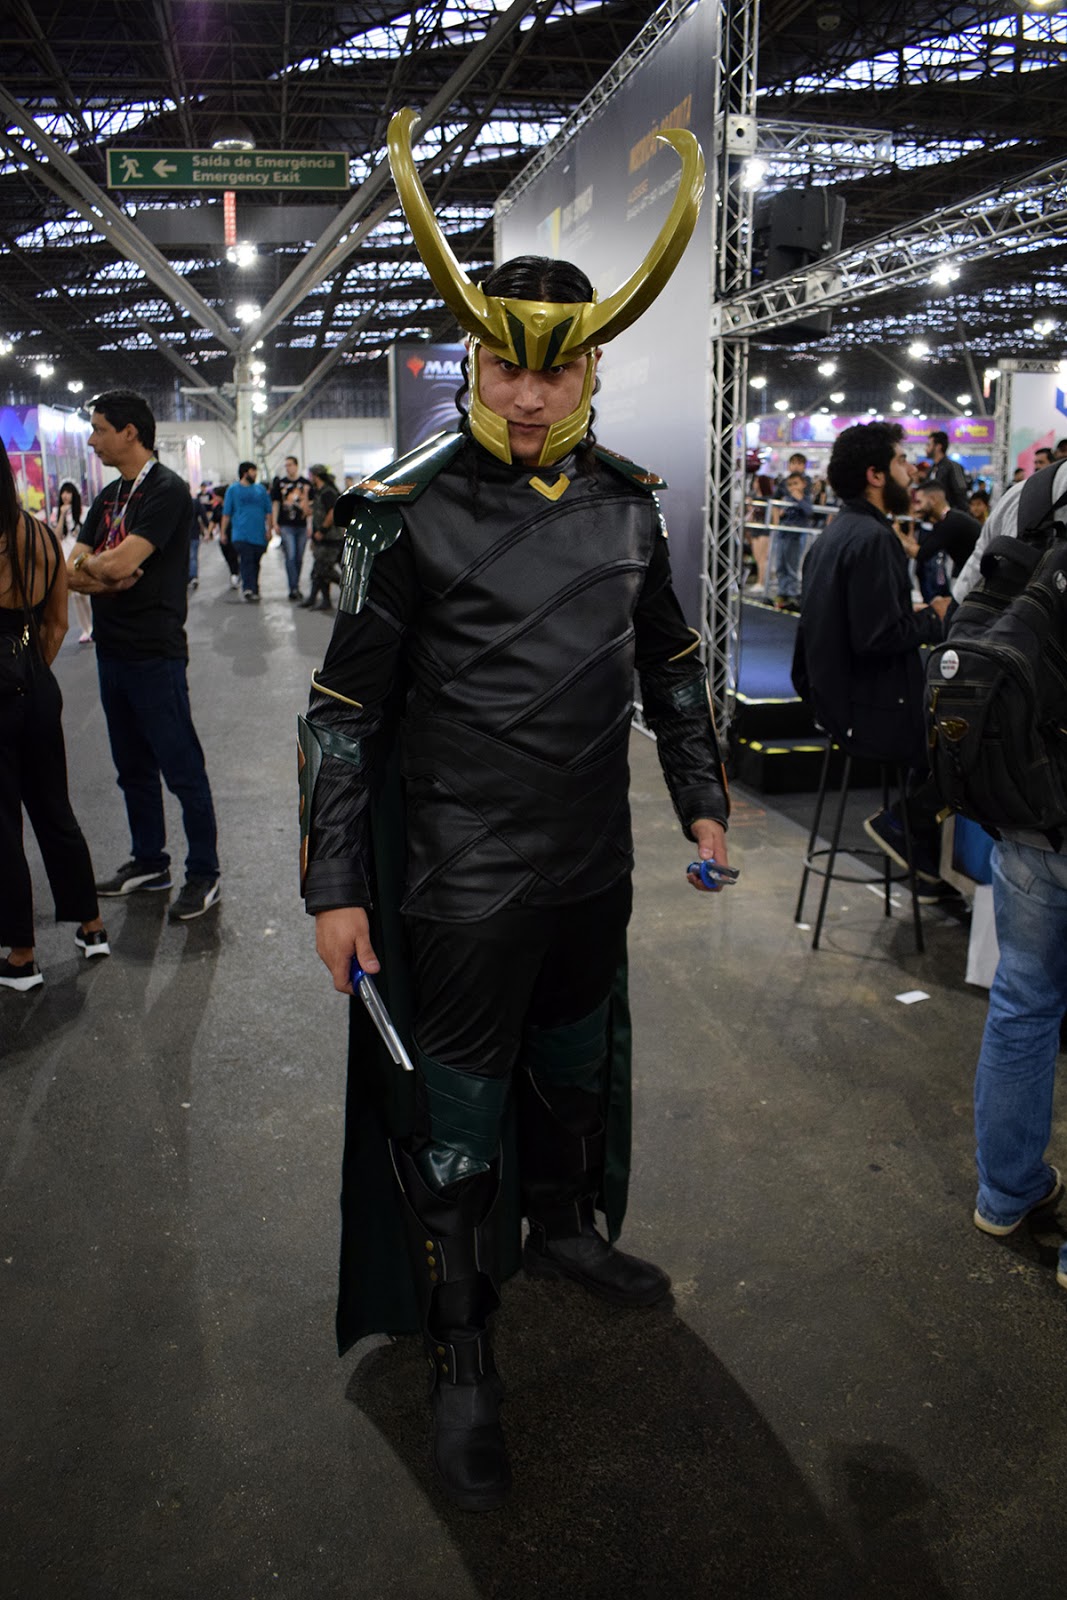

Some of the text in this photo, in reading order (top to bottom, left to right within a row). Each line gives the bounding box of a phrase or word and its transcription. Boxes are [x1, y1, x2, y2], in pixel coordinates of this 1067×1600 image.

[192, 155, 335, 170] Saída de Emergência
[192, 171, 300, 185] Emergency Exit
